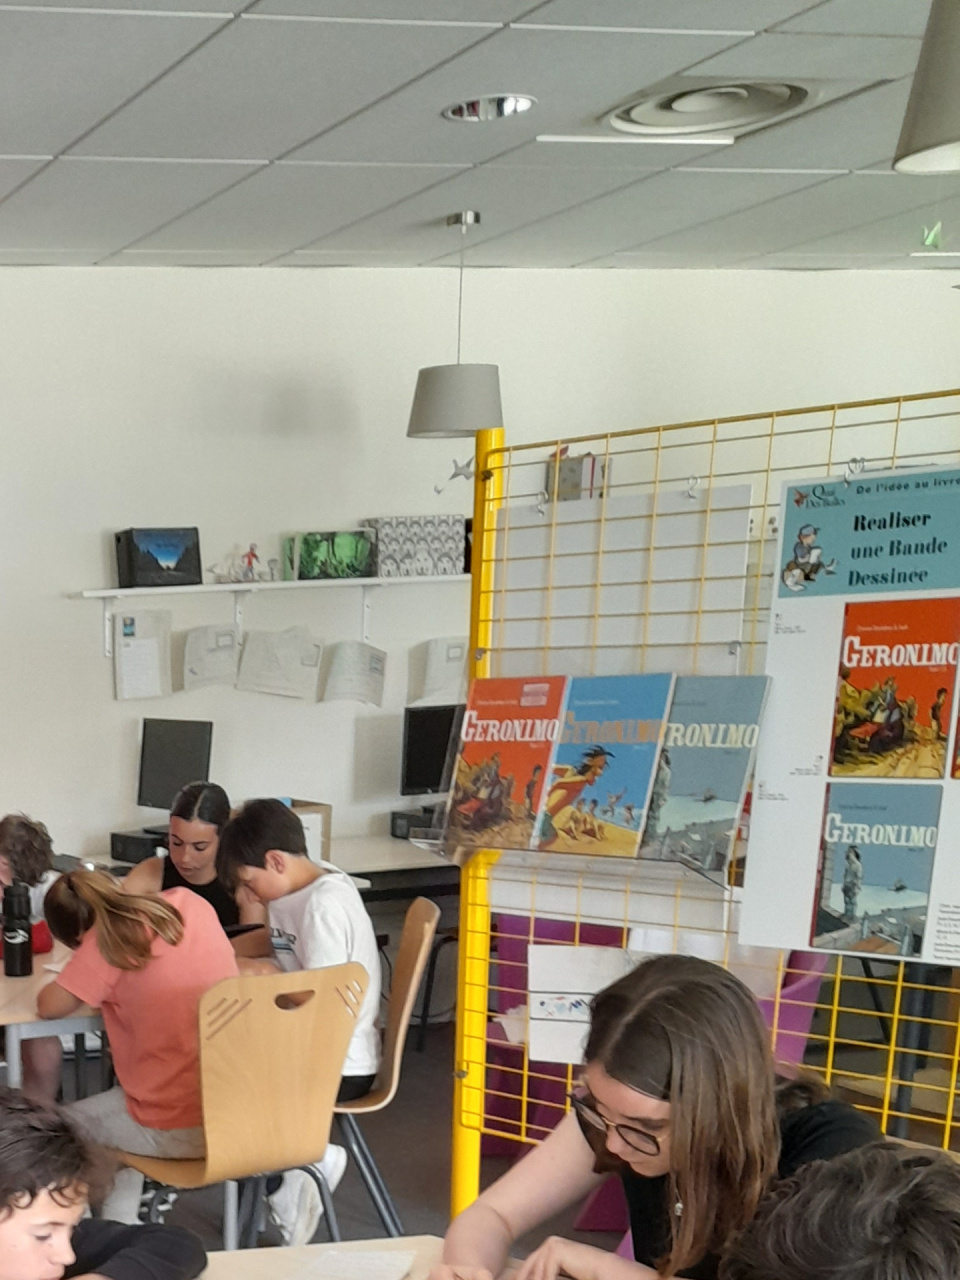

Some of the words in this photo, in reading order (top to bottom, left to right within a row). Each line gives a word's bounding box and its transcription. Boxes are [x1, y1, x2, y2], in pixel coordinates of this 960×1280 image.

[856, 485, 871, 494] De
[915, 481, 929, 489] au
[851, 545, 884, 560] une
[889, 537, 948, 556] Bande
[843, 635, 959, 668] GERONIMO
[461, 710, 559, 742] GERONIMO
[667, 722, 760, 748] RONIMO
[824, 812, 938, 848] GERONIMO
